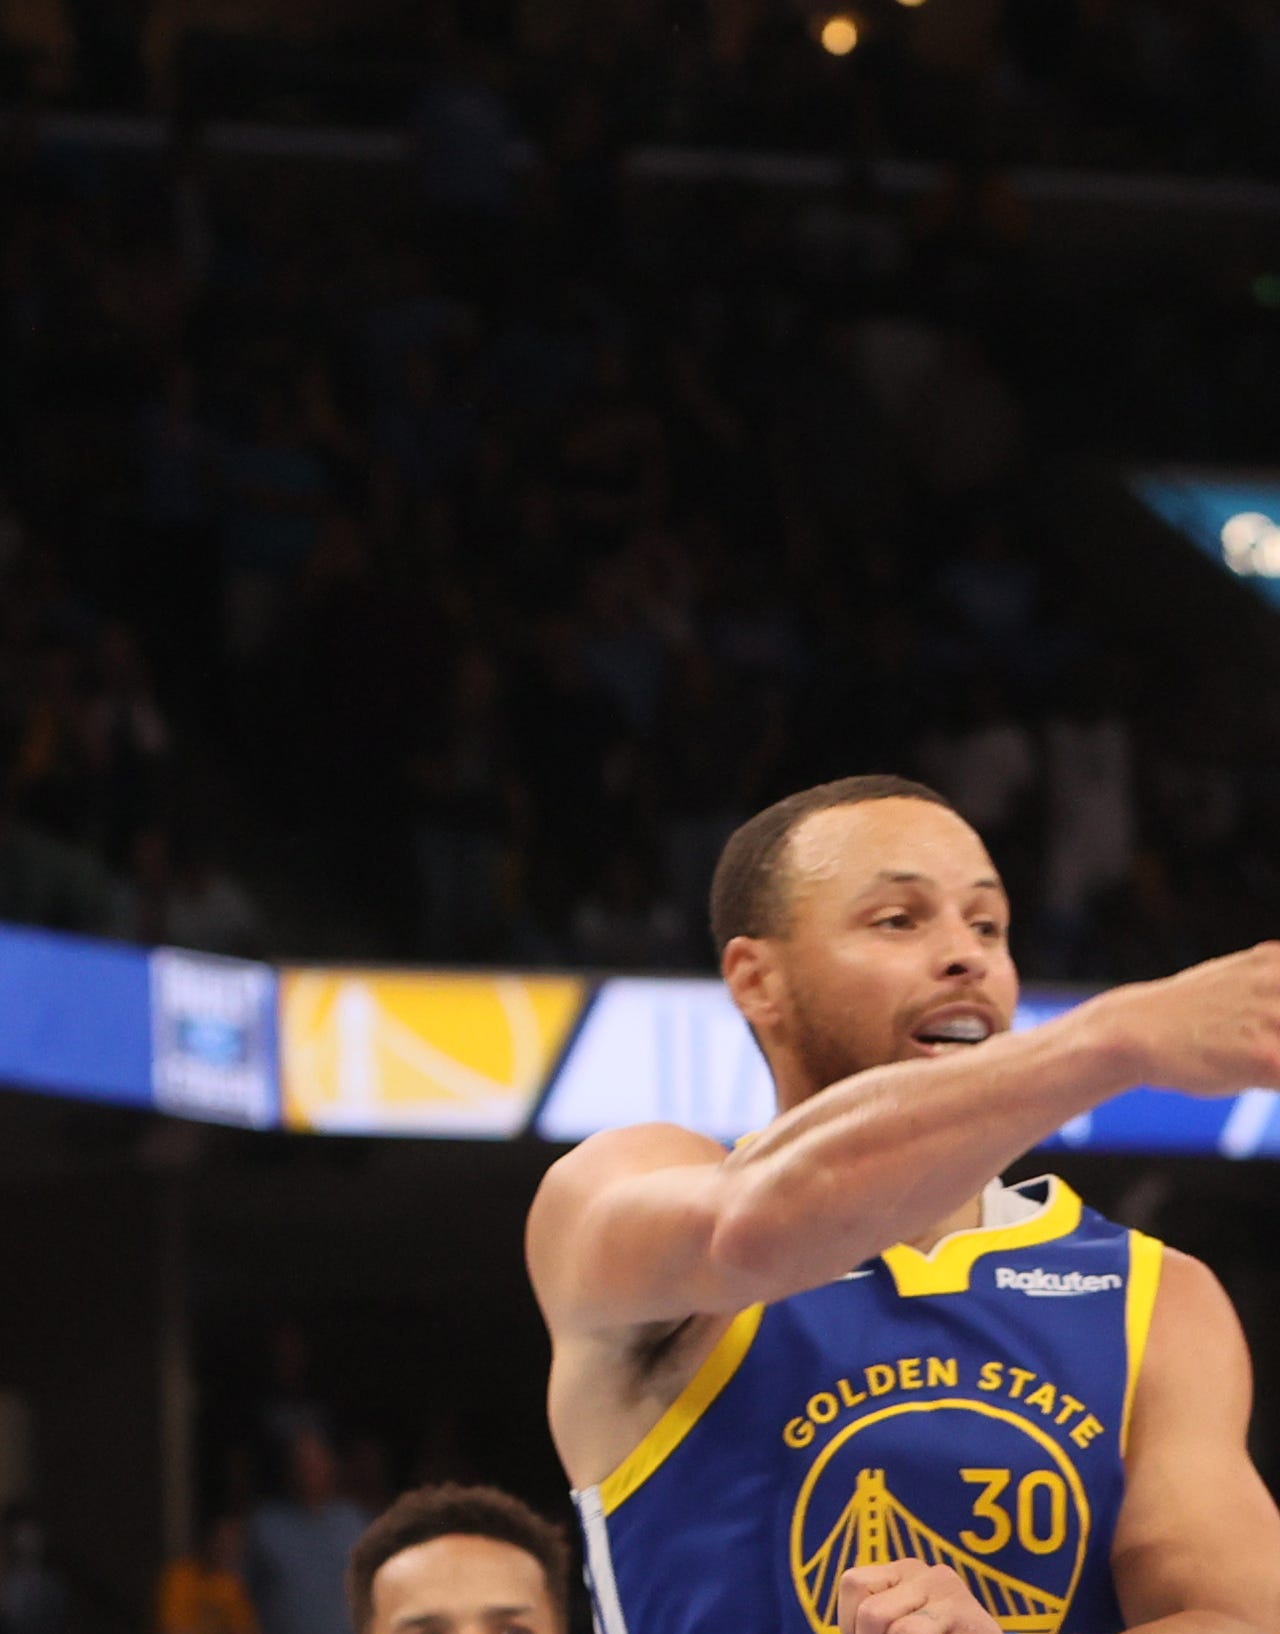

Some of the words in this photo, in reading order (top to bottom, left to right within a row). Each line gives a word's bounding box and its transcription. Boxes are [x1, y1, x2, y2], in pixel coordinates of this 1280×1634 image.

[995, 1267, 1122, 1294] Rakuten
[783, 1356, 958, 1450] GOLDEN
[976, 1361, 1105, 1449] STATE
[958, 1469, 1067, 1555] 30
